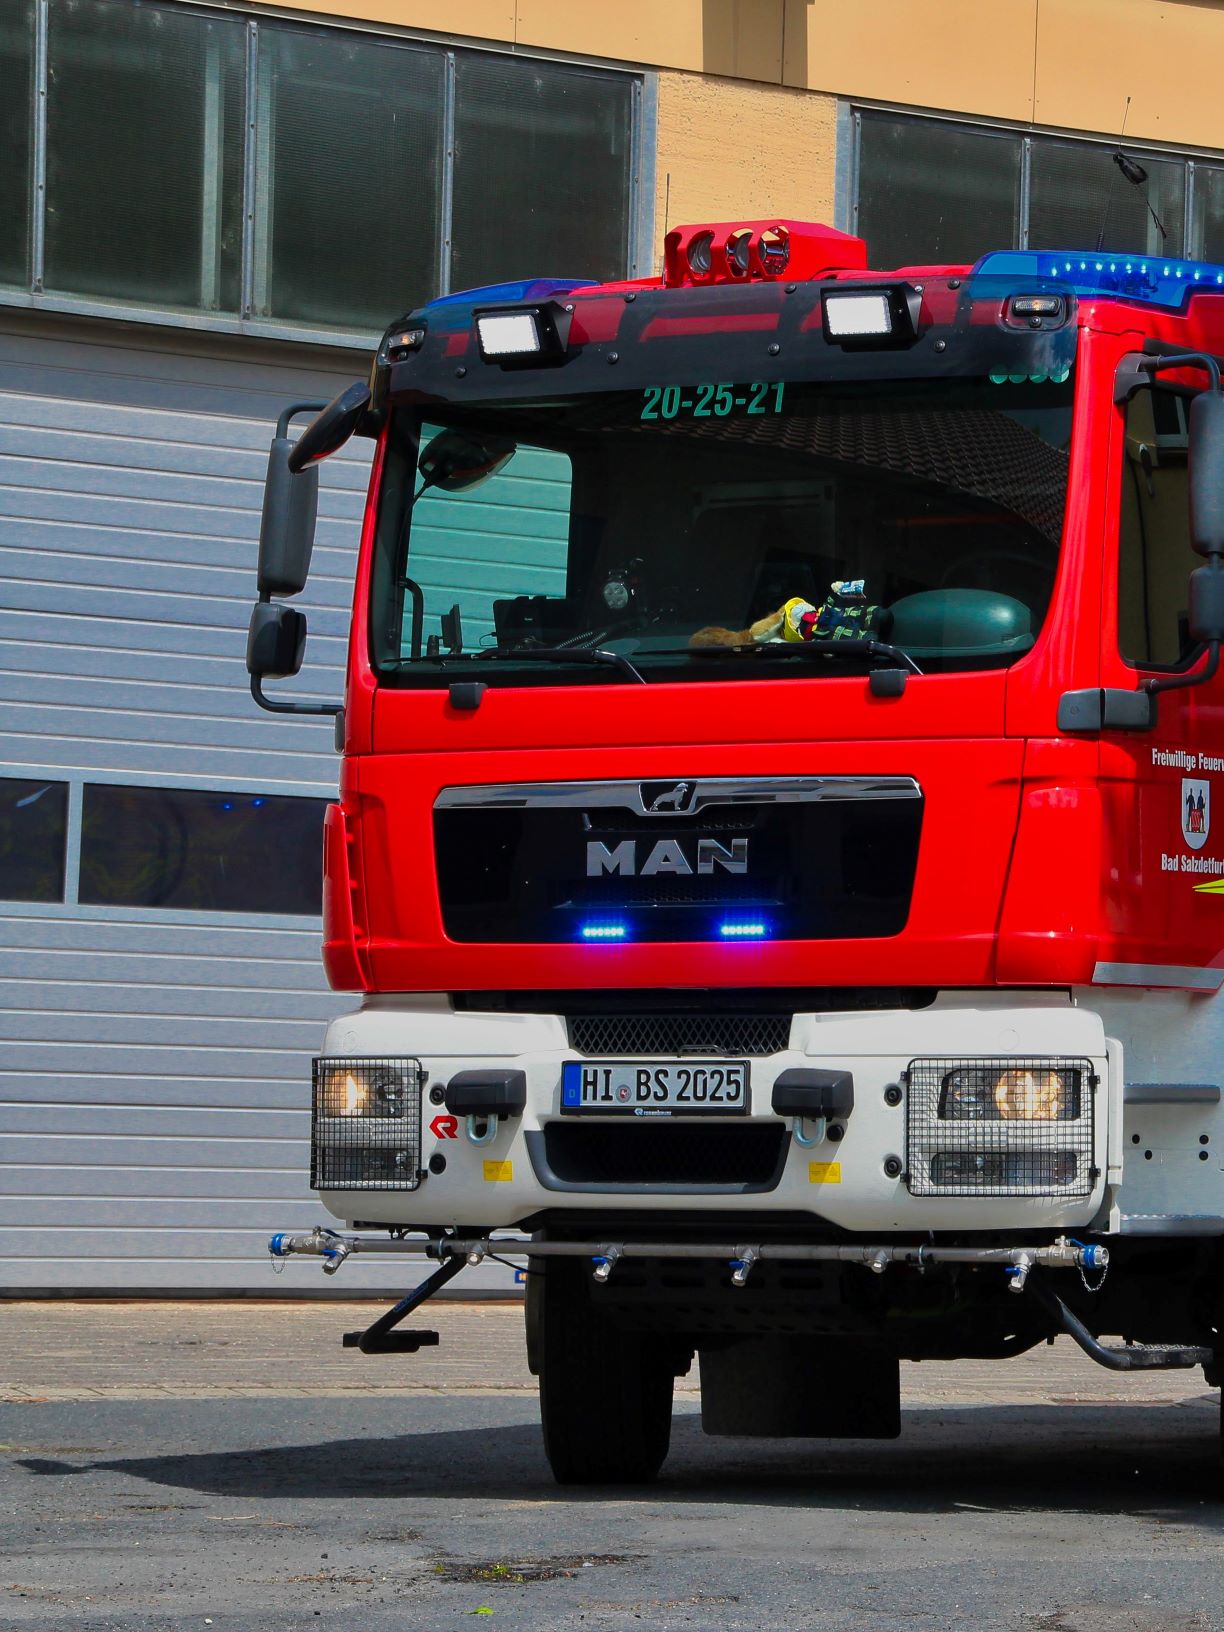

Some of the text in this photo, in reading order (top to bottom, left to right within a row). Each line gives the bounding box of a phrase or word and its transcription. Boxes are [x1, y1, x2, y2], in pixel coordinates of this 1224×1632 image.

[640, 380, 785, 420] 20-25-21
[1151, 748, 1196, 772] Freiwillige
[586, 838, 749, 877] MAN
[1161, 853, 1179, 872] Bad
[582, 1069, 614, 1101] HI
[636, 1069, 669, 1101] BS
[676, 1069, 741, 1101] 2025
